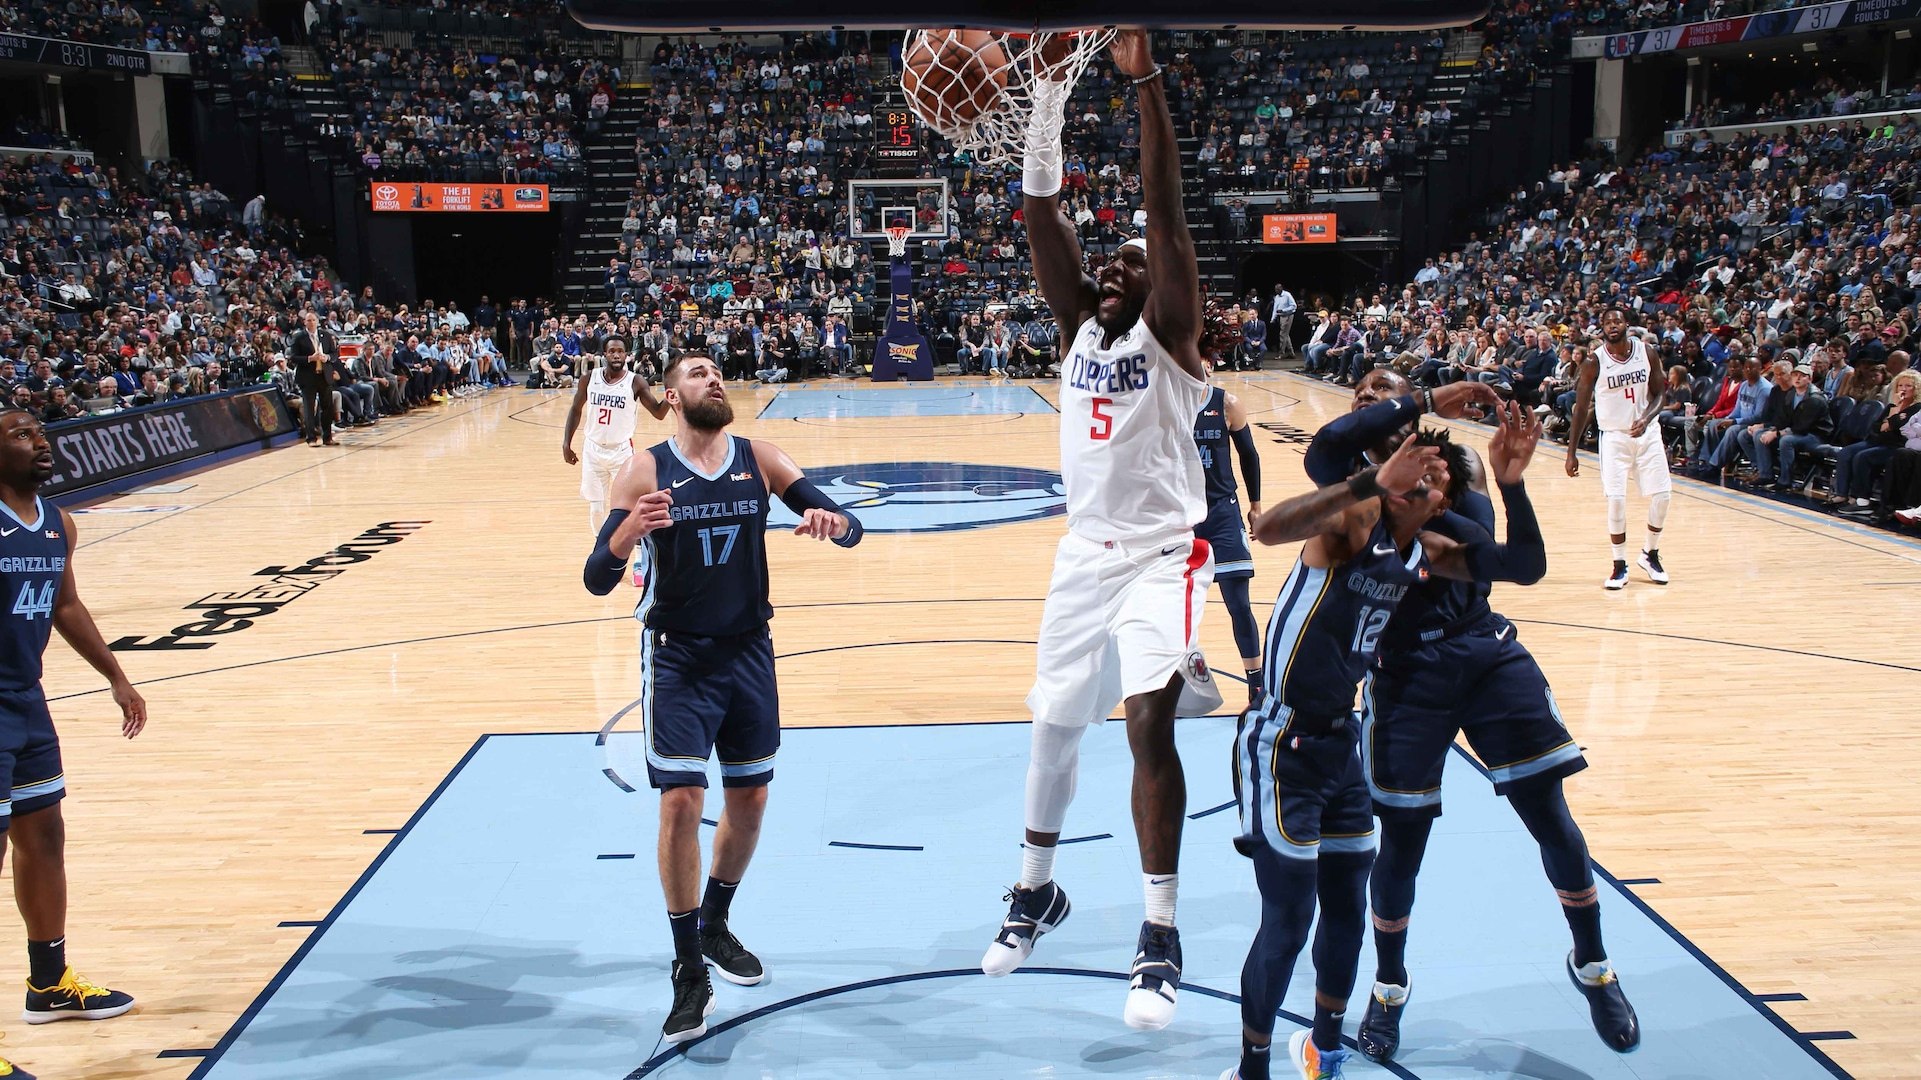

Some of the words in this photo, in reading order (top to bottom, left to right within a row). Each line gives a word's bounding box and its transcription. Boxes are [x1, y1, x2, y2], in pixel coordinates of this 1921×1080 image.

[1811, 7, 1831, 29] 37
[1854, 10, 1881, 23] FOULS:
[1883, 9, 1890, 19] 0
[1690, 22, 1726, 36] TIMEOUTS:
[1726, 21, 1731, 31] 6
[1654, 30, 1671, 50] 37
[1688, 35, 1711, 46] FOULS:
[1712, 34, 1717, 43] 2
[62, 44, 93, 67] 8:31
[107, 53, 126, 67] 2ND
[128, 56, 145, 70] QTR
[889, 113, 914, 125] 8:31
[893, 125, 911, 146] 15
[442, 186, 460, 196] THE
[462, 186, 471, 196] #1
[443, 195, 471, 204] FORKLIFT
[891, 347, 917, 356] SONIC
[1070, 352, 1149, 394] CLIPPERS
[1607, 368, 1647, 390] CLIPPERS
[590, 391, 627, 409] CLIPPERS
[1624, 387, 1635, 404] 4
[598, 408, 612, 425] 21
[1090, 397, 1113, 441] 5
[57, 422, 146, 478] STARTS
[142, 411, 199, 459] HERE
[730, 472, 753, 482] FedEx
[670, 499, 759, 522] GRIZZLIES
[697, 524, 741, 567] 17
[0, 556, 66, 573] GRIZZLIES
[12, 579, 55, 621] 44
[1352, 605, 1390, 652] 12
